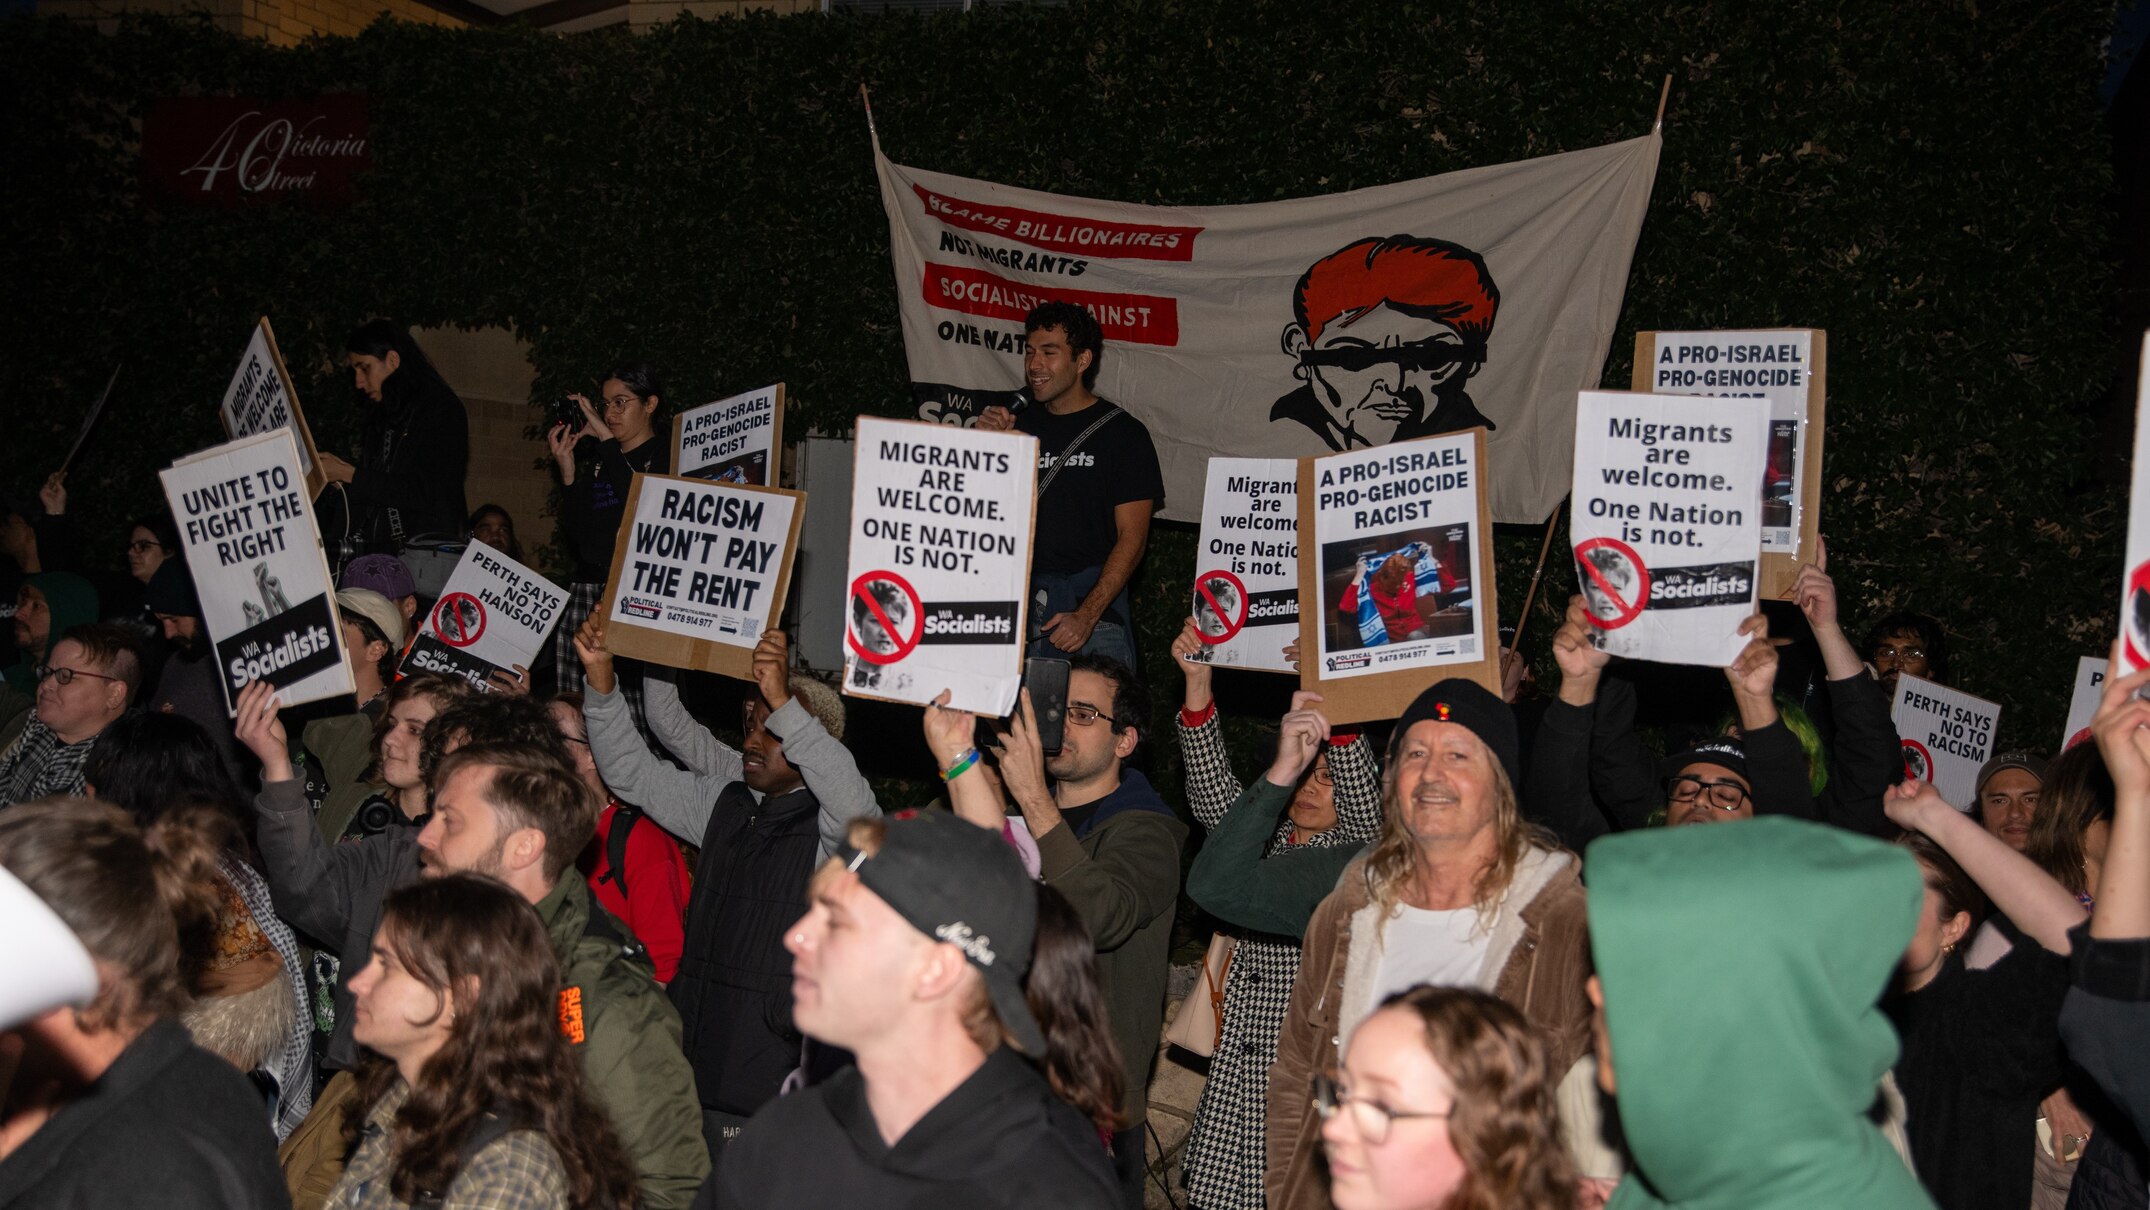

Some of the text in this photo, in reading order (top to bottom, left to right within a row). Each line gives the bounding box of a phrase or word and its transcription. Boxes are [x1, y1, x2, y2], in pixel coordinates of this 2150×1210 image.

[266, 115, 366, 158] Victoria
[180, 111, 293, 192] 40
[929, 194, 1183, 249] BLAME BILLIONAIRES
[939, 231, 1088, 277] NOT MIGRANTS
[1074, 303, 1151, 328] AINST
[937, 320, 1026, 355] ONE NAT
[1659, 344, 1802, 363] A PRO-ISRAEL
[230, 353, 262, 424] MIGRANTS
[1658, 369, 1801, 387] PRO-GENOCIDE
[246, 368, 281, 435] WELCOME
[269, 400, 288, 430] ARE
[684, 396, 771, 434] A PRO-ISRAEL
[947, 392, 972, 412] WA
[683, 413, 770, 450] PRO-GENOCIDE
[1608, 418, 1733, 446] Migrants
[701, 435, 747, 461] RACIST
[880, 440, 1010, 474] MIGRANTS
[1645, 447, 1690, 465] are
[918, 469, 966, 493] ARE
[1320, 448, 1467, 488] A PRO-ISRAEL
[1601, 466, 1733, 491] welcome.
[182, 465, 290, 516] UNITE TO
[1227, 476, 1298, 498] Migrant
[1320, 471, 1468, 511] PRO-GENOCIDE
[186, 491, 303, 546] FIGHT THE
[660, 488, 764, 532] RACISM
[877, 487, 1005, 522] WELCOME.
[1251, 499, 1281, 512] are
[1354, 500, 1432, 529] RACIST
[1588, 497, 1743, 526] One Nation
[216, 526, 287, 567] RIGHT
[635, 522, 778, 574] WON'T PAY
[863, 518, 1016, 556] ONE NATION
[1210, 538, 1298, 558] One Natio
[1621, 522, 1703, 548] is not.
[894, 545, 979, 575] IS NOT.
[1231, 557, 1287, 576] is not.
[472, 551, 561, 610] PERTH SAYS
[632, 560, 761, 612] THE RENT
[1650, 576, 1748, 600] Socialists
[1665, 575, 1682, 584] WA
[478, 588, 546, 635] HANSON
[503, 587, 552, 622] NO TO
[627, 607, 654, 618] REDLINE
[630, 596, 663, 609] POLITICAL
[937, 609, 954, 620] WA
[1248, 599, 1299, 618] Socialis
[1259, 598, 1270, 606] WA
[667, 612, 685, 623] 0478
[686, 615, 698, 625] 914
[698, 618, 713, 628] 977
[924, 614, 1011, 635] Socialists
[231, 625, 331, 688] Socialists
[241, 640, 261, 659] WA
[433, 649, 449, 662] WA
[1335, 652, 1372, 661] POLITICAL
[1378, 654, 1397, 663] 0478
[1399, 652, 1411, 660] 914
[1413, 649, 1427, 658] 977
[1903, 690, 1992, 732] PERTH SAYS
[1927, 732, 1985, 763] RACISM
[1940, 719, 1988, 747] NO TO
[567, 986, 585, 1044] SUPER
